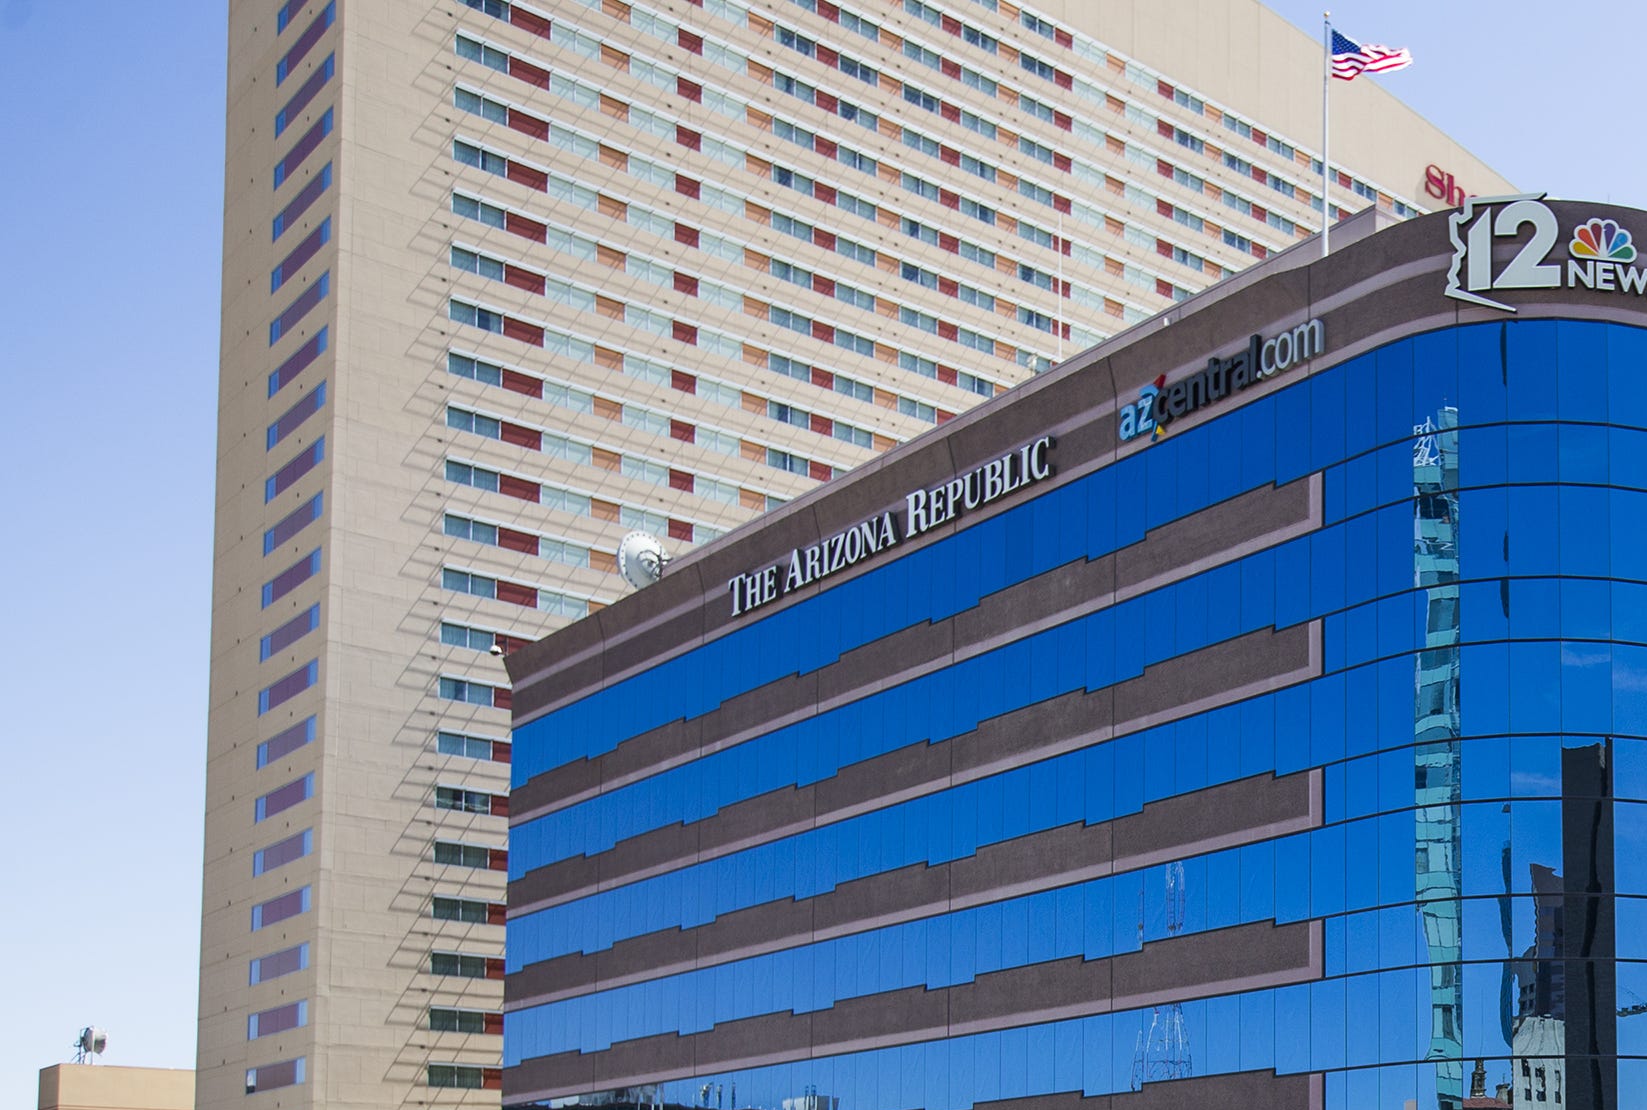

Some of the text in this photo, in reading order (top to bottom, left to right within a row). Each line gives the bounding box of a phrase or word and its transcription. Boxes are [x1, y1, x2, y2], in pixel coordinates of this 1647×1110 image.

[1468, 200, 1561, 291] 12
[1119, 318, 1325, 441] azcentral.com
[728, 436, 1051, 617] THE ARIZONA REPUBLIC
